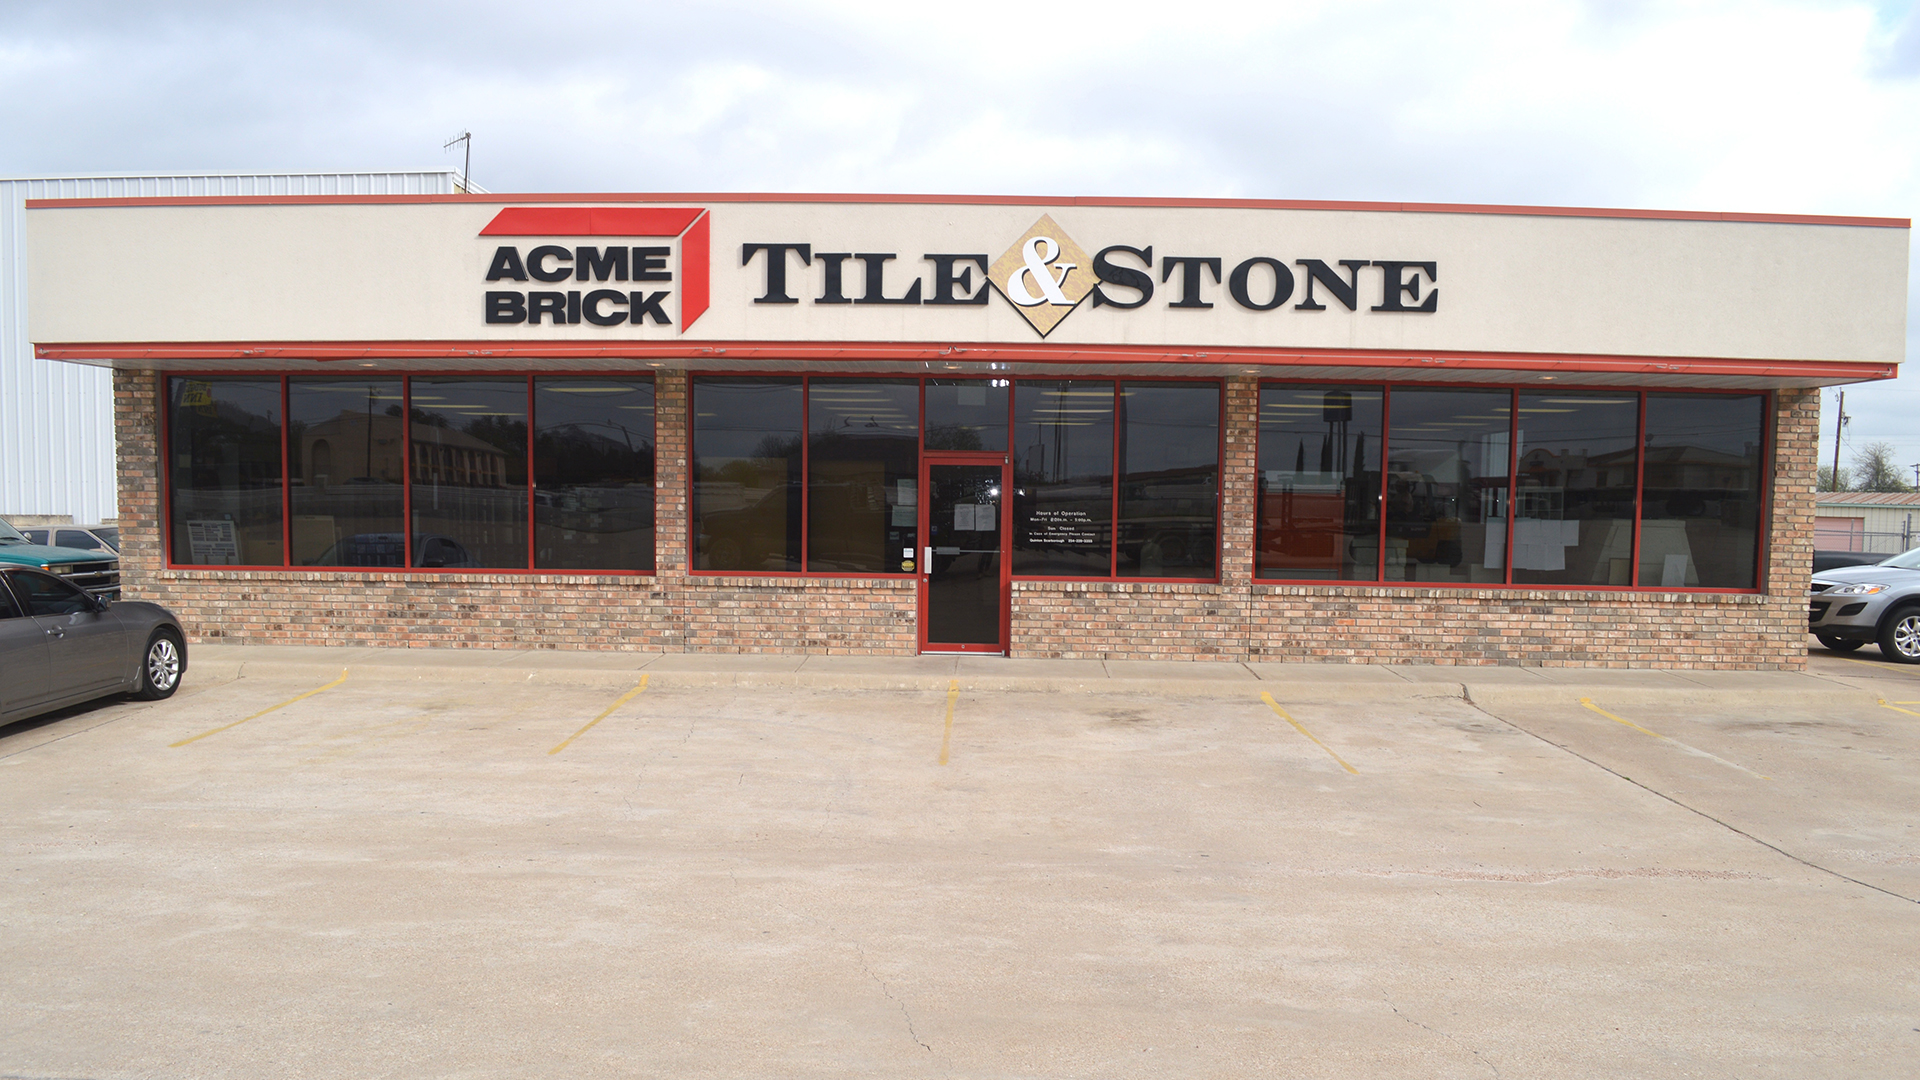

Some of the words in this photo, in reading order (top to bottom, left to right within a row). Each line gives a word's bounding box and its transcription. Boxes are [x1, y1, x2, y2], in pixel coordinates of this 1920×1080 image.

[485, 245, 672, 283] ACME
[742, 243, 989, 305] TILE
[1007, 236, 1078, 307] &
[1092, 245, 1438, 313] STONE
[485, 289, 672, 326] BRICK
